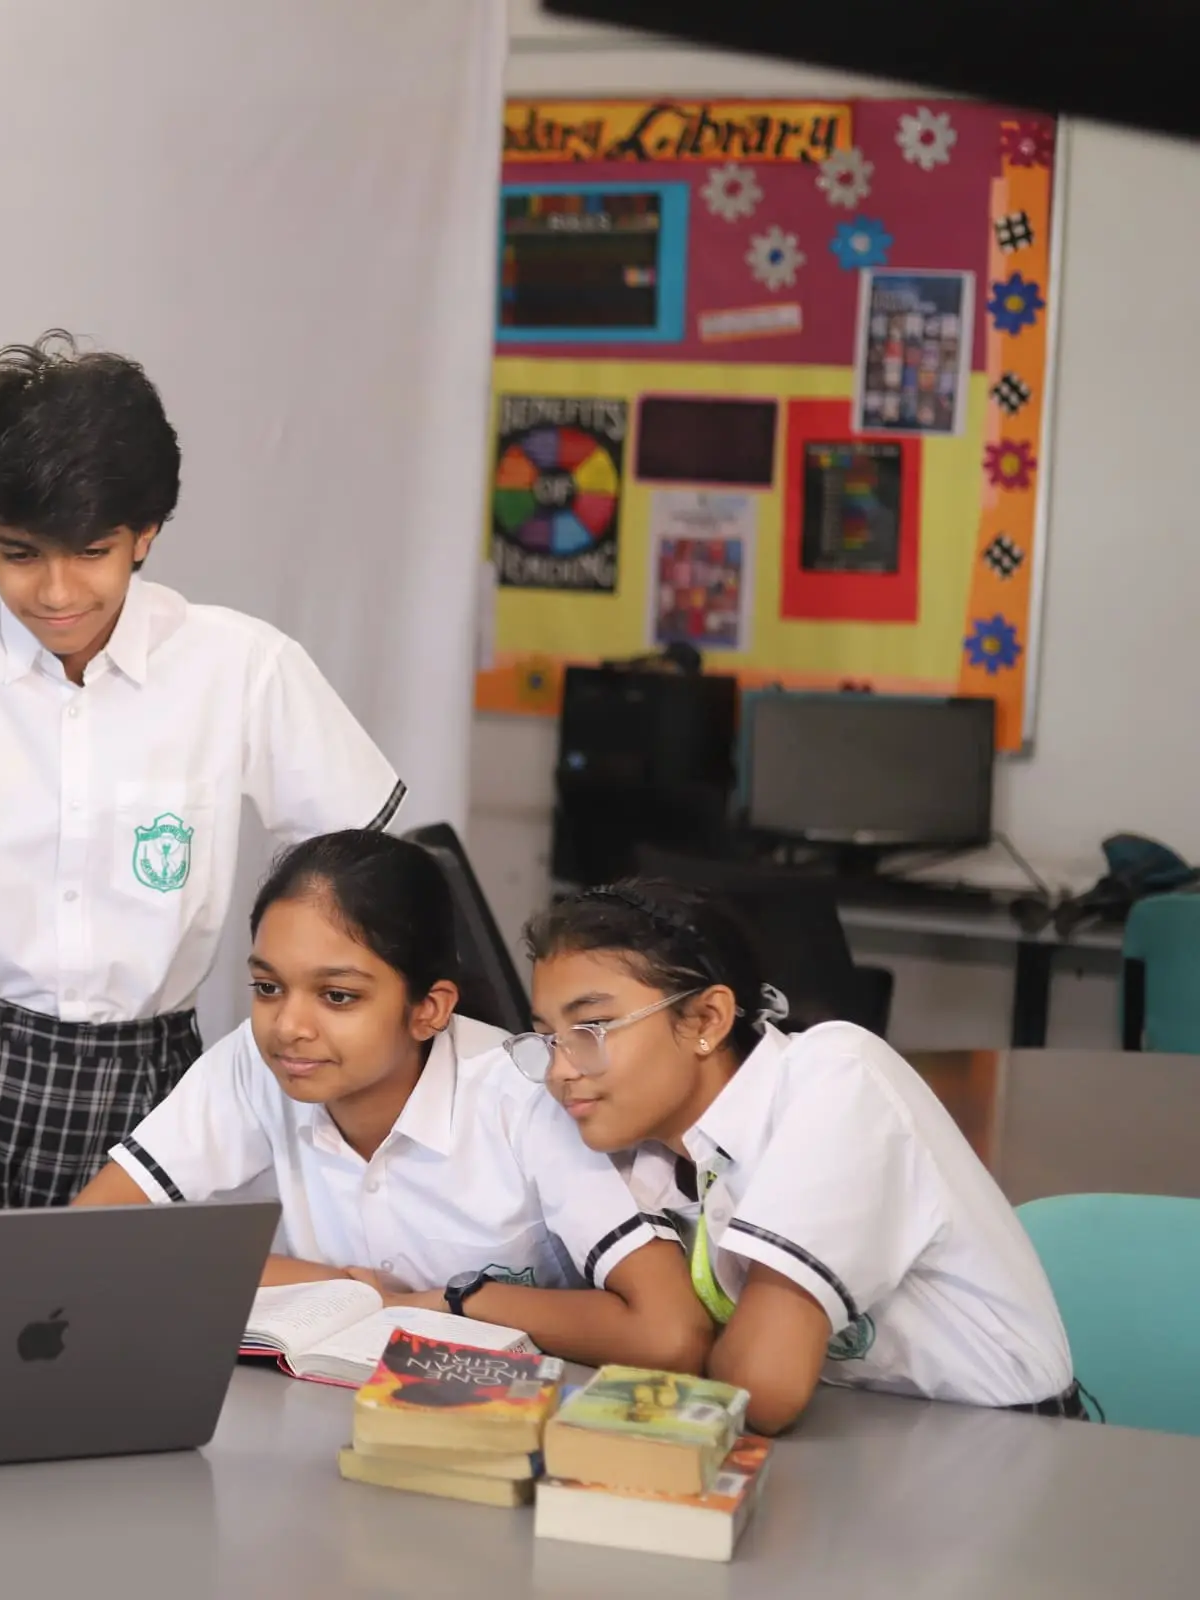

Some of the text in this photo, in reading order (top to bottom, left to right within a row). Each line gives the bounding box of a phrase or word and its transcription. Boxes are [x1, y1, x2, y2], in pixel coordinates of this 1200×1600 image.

[604, 103, 841, 163] Library
[406, 1357, 528, 1381] INDIAN
[435, 1352, 510, 1369] GIRL
[424, 1368, 502, 1386] ONE
